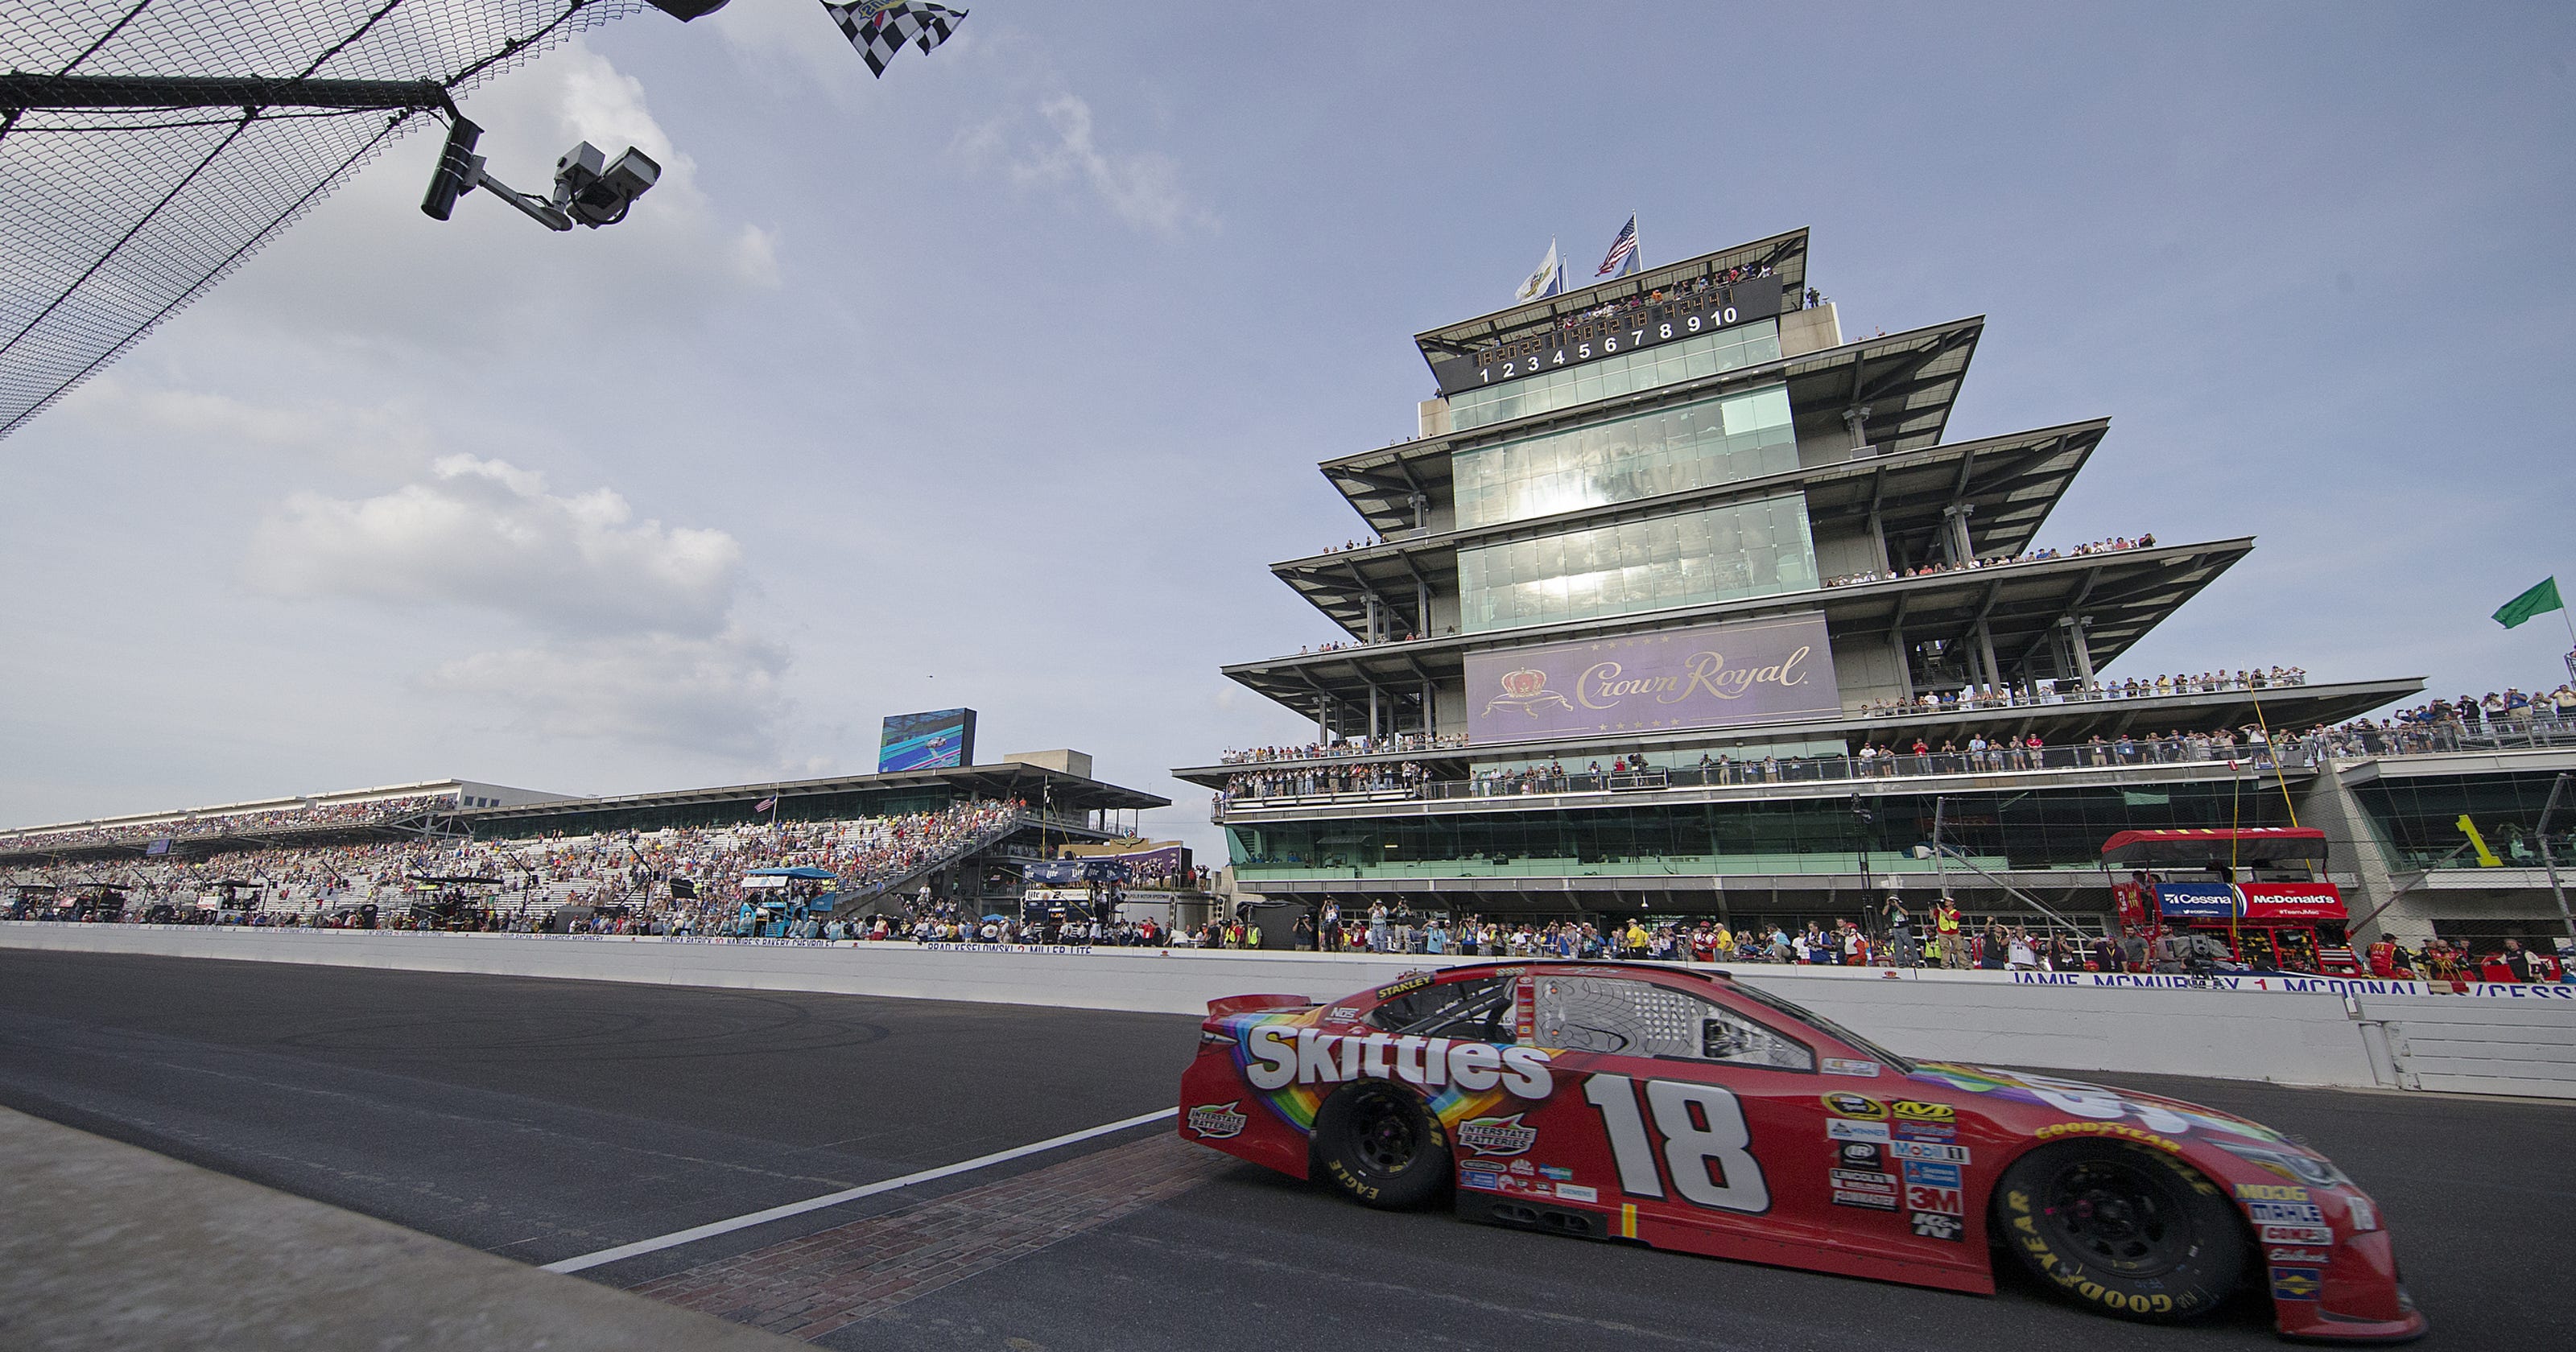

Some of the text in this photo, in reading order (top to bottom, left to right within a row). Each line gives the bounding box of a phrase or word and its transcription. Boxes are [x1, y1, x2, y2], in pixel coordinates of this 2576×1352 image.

[1480, 307, 1737, 382] 1 2 3 4 5 6 7 8 9 10
[1575, 661, 1678, 710] Crown
[2455, 814, 2504, 868] 1
[2178, 893, 2231, 905] Cessna
[2253, 895, 2335, 904] McDonald's
[1378, 975, 1431, 999] STANLEY
[2014, 971, 2080, 985] JAMIE
[2093, 974, 2240, 990] MCMURAY
[2253, 978, 2268, 991] 1
[1245, 1024, 1554, 1100] Skittles
[1191, 1111, 1242, 1124] INTERSTATE
[1193, 1119, 1239, 1131] BATTERIES
[1462, 1125, 1531, 1139] INTERSTATE
[1465, 1136, 1527, 1148] BATTERIES
[1583, 1071, 1770, 1214] 18
[2035, 1122, 2182, 1152] GOODYEAR
[1895, 1142, 1942, 1157] Mobil
[1328, 1159, 1381, 1201] EAGLE
[1910, 1186, 1959, 1214] 3M
[2008, 1189, 2174, 1314] GOODYEAR
